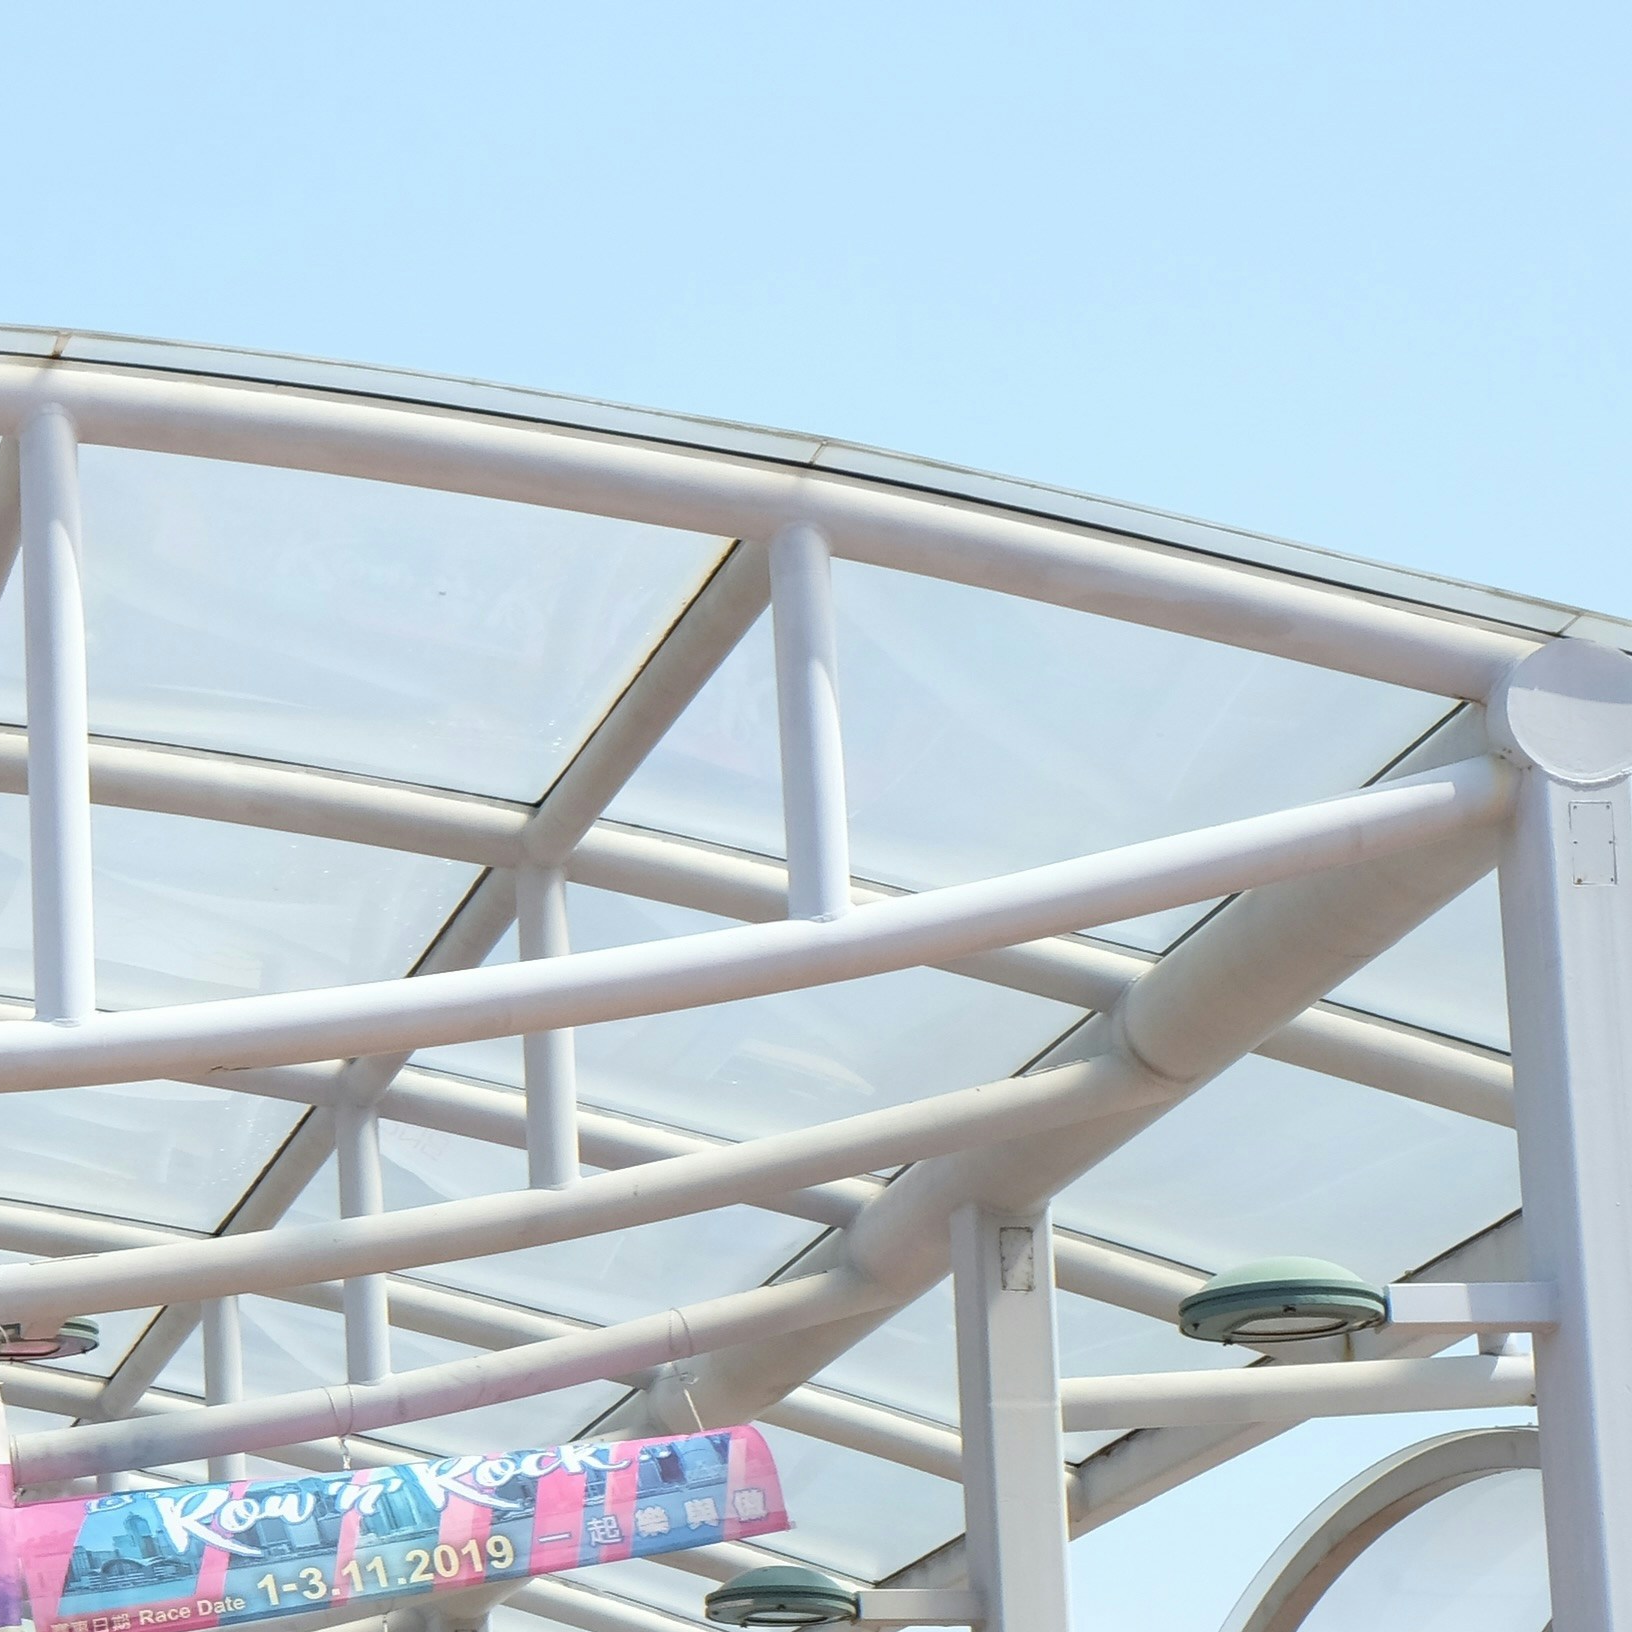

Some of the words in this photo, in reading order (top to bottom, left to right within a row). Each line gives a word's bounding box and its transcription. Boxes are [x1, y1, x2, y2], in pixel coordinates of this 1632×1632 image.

[153, 1486, 317, 1558] Row
[410, 1441, 630, 1511] Rock
[139, 1605, 192, 1626] Race
[197, 1596, 247, 1617] Date
[256, 1534, 515, 1606] 1-3.11.2019
